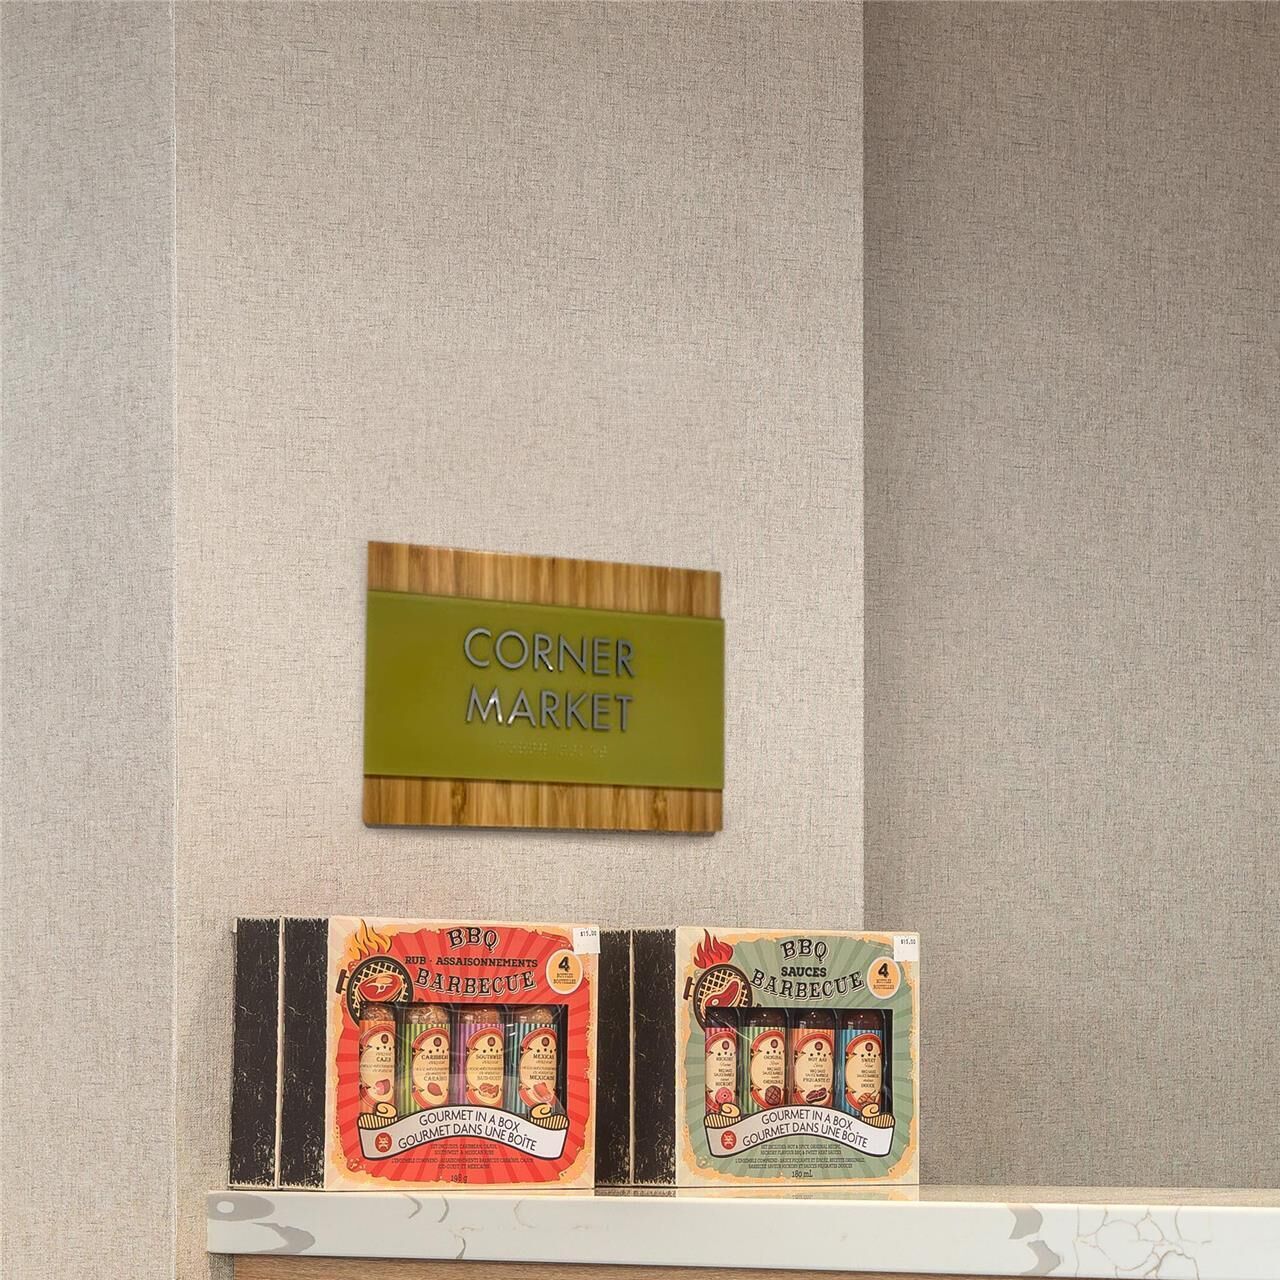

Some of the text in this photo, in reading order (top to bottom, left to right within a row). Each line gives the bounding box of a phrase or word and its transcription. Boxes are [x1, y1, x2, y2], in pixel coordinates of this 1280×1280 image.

[464, 627, 637, 679] CORNER
[466, 683, 634, 733] MARKET
[446, 926, 501, 955] BBQ
[780, 938, 829, 963] BBQ
[405, 956, 538, 969] RUB ASSAISONNEMENTS
[557, 955, 571, 973] 4
[780, 966, 827, 978] SAUCES
[878, 962, 891, 979] 4
[414, 967, 538, 998] BARBECUE
[750, 968, 865, 1000] BARBECUE
[418, 1109, 521, 1134] GOURMET IN A BOX
[761, 1109, 853, 1131] GOURMET IN A BOX
[398, 1123, 451, 1150] GOURMET
[452, 1123, 483, 1137] DANS
[484, 1125, 508, 1142] UNE
[508, 1130, 538, 1152] BOÎTE
[743, 1123, 790, 1148] GOURMET
[792, 1122, 820, 1134] DANS
[820, 1124, 840, 1139] UNE
[841, 1130, 869, 1149] BOÎTE
